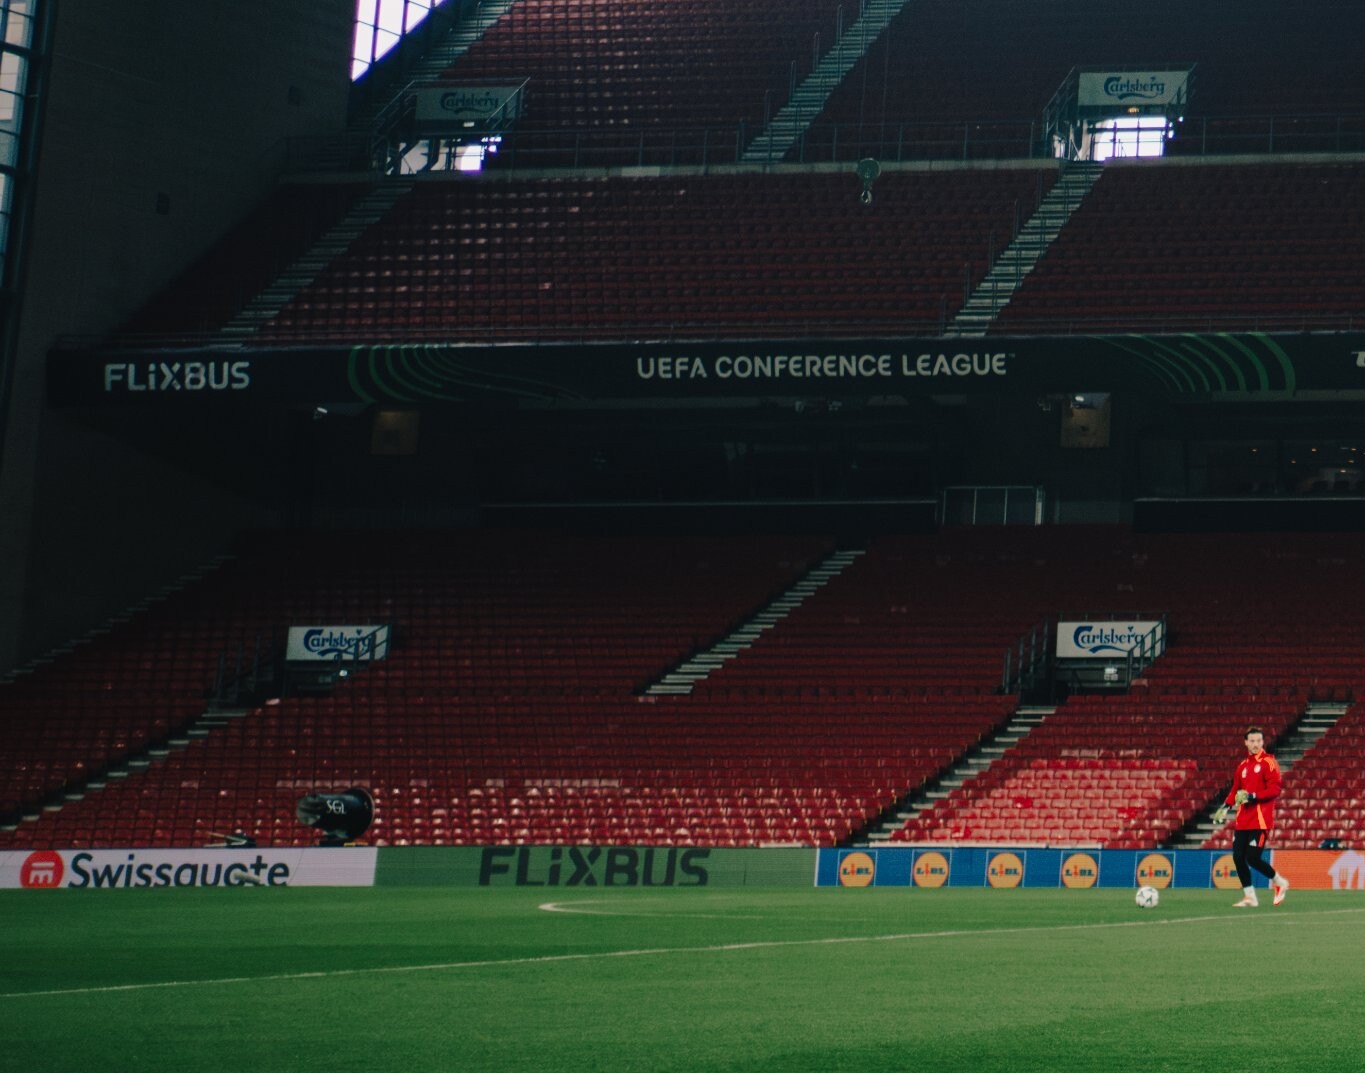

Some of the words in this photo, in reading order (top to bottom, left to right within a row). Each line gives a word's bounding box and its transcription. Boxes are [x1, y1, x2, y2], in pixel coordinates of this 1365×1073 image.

[1104, 76, 1165, 100] Carlsberg
[636, 356, 707, 379] UEFA
[715, 354, 892, 378] CONFERENCE
[902, 352, 1007, 376] LEAGUE
